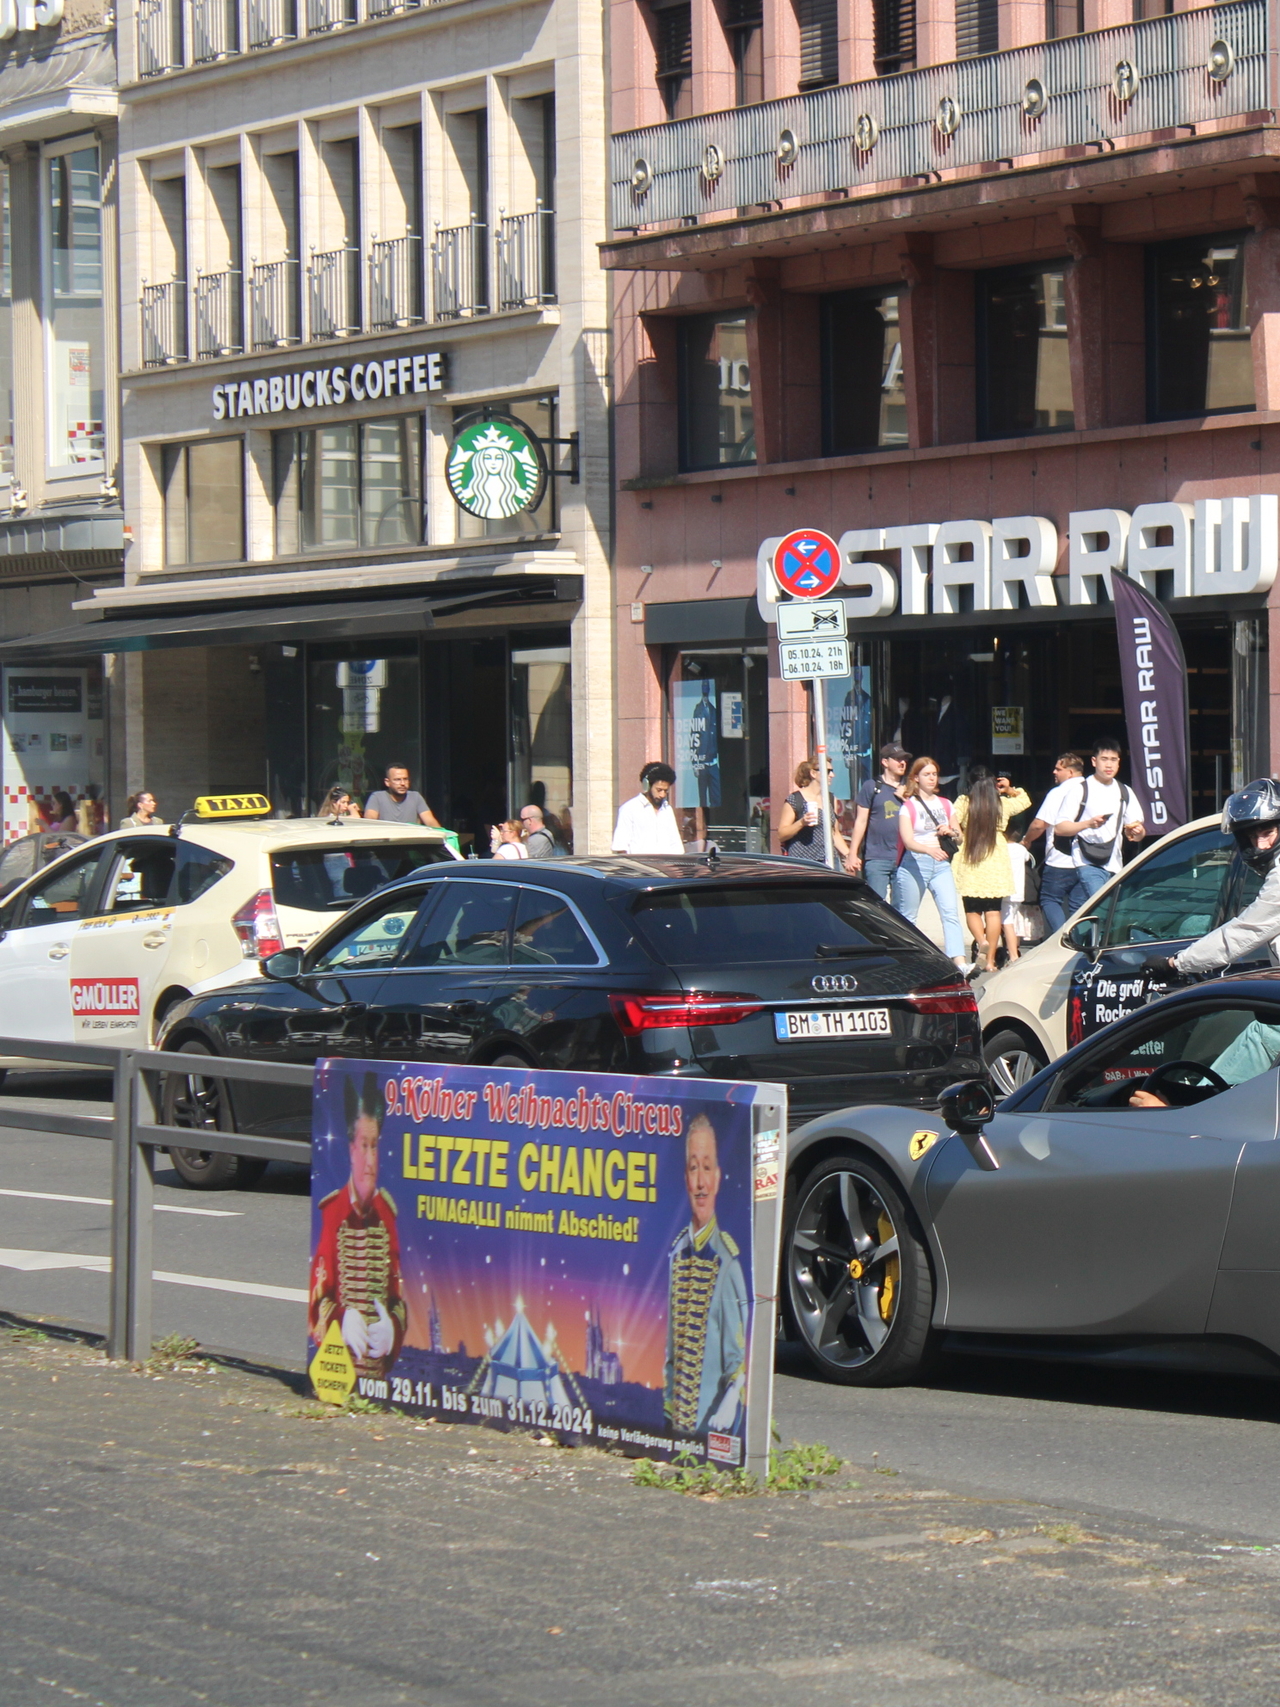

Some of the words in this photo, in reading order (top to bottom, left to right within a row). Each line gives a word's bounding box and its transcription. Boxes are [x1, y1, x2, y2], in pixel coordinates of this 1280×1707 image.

[212, 366, 346, 420] STARBUCKS
[351, 353, 443, 401] COFFEE
[1069, 494, 1278, 606] RAW
[788, 648, 823, 659] 05.10.24.
[828, 646, 843, 657] 21h
[1133, 617, 1156, 692] RAW
[829, 660, 844, 671] 18h
[826, 706, 858, 720] DENIM
[995, 709, 1006, 717] WE
[676, 718, 706, 732] DENIM
[826, 722, 852, 738] DAYS
[677, 733, 700, 748] DAYS
[1140, 700, 1168, 825] G-STAR
[212, 797, 261, 810] TAXI
[71, 982, 139, 1011] GMÜLLER
[1096, 979, 1118, 998] Die
[788, 1014, 810, 1034] BM
[822, 1013, 844, 1033] TH
[847, 1011, 888, 1032] 1103
[402, 1076, 477, 1123] Kölner
[483, 1081, 683, 1137] WeihnachtsCircus
[402, 1132, 509, 1188] LETZTE
[518, 1142, 657, 1202] CHANCE!
[417, 1194, 500, 1228] FUMAGALLI
[505, 1205, 554, 1233] nimmt
[558, 1210, 638, 1243] Abschied!
[324, 1344, 345, 1356] JETZT
[319, 1360, 347, 1375] TICKETS
[358, 1377, 388, 1399] vom
[392, 1377, 437, 1407] 29.11.
[442, 1385, 467, 1412] bis
[472, 1395, 502, 1418] zum
[507, 1395, 593, 1435] 31.12.2024
[598, 1424, 619, 1440] keine
